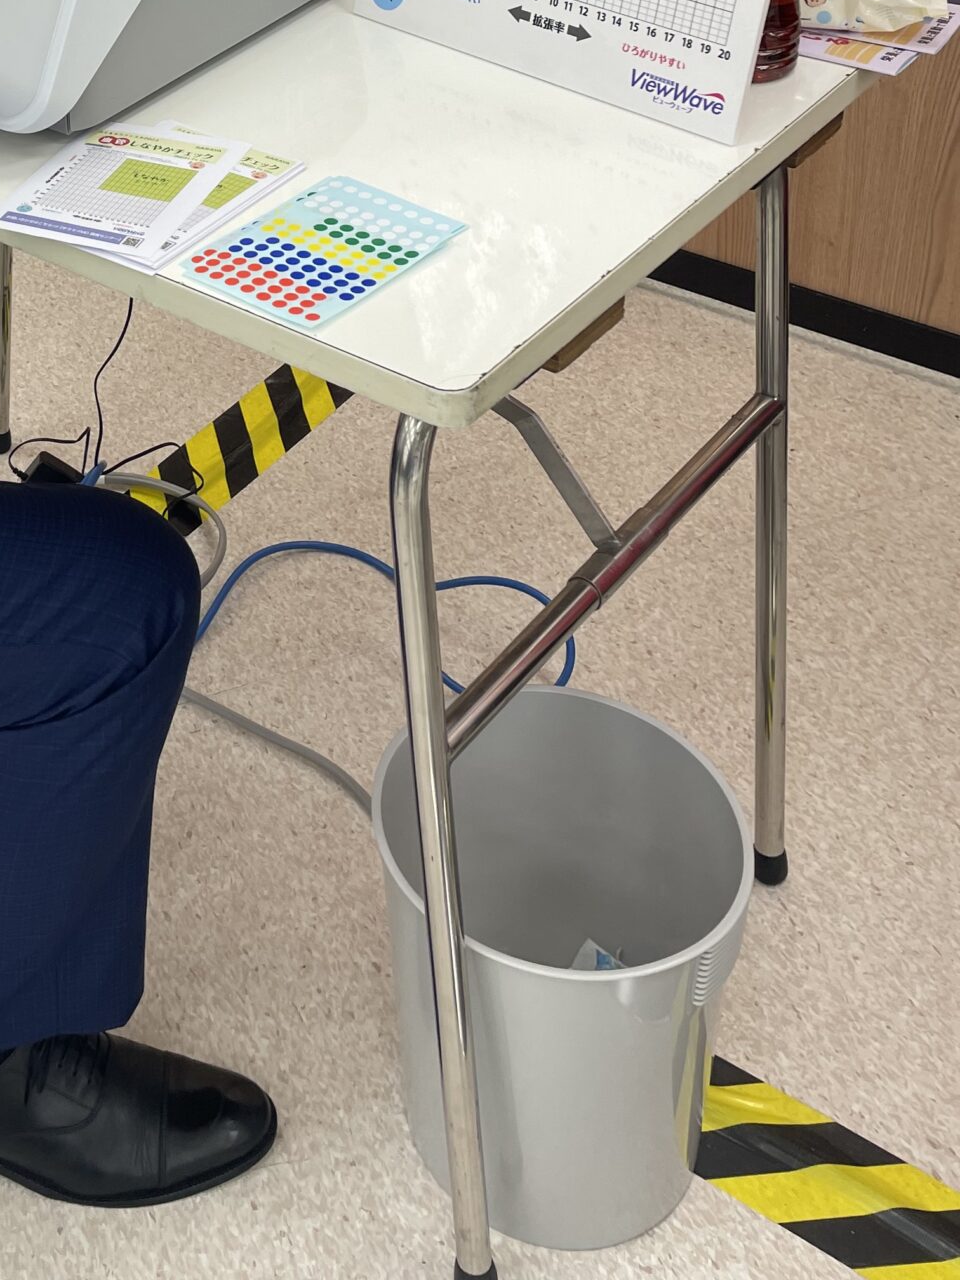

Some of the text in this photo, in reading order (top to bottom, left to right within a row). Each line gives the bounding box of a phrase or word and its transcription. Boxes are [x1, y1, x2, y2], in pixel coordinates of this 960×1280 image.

[564, 1, 573, 12] 11
[579, 5, 589, 17] 12
[596, 11, 607, 22] 13
[612, 15, 622, 27] 14
[532, 13, 565, 34] 拡張率
[629, 21, 640, 32] 15
[646, 26, 657, 38] 16
[664, 31, 675, 43] 17
[682, 37, 693, 49] 18
[700, 43, 712, 54] 19
[622, 42, 686, 71] ひろがりやすい
[718, 48, 731, 61] 20
[630, 68, 724, 116] ViewWave
